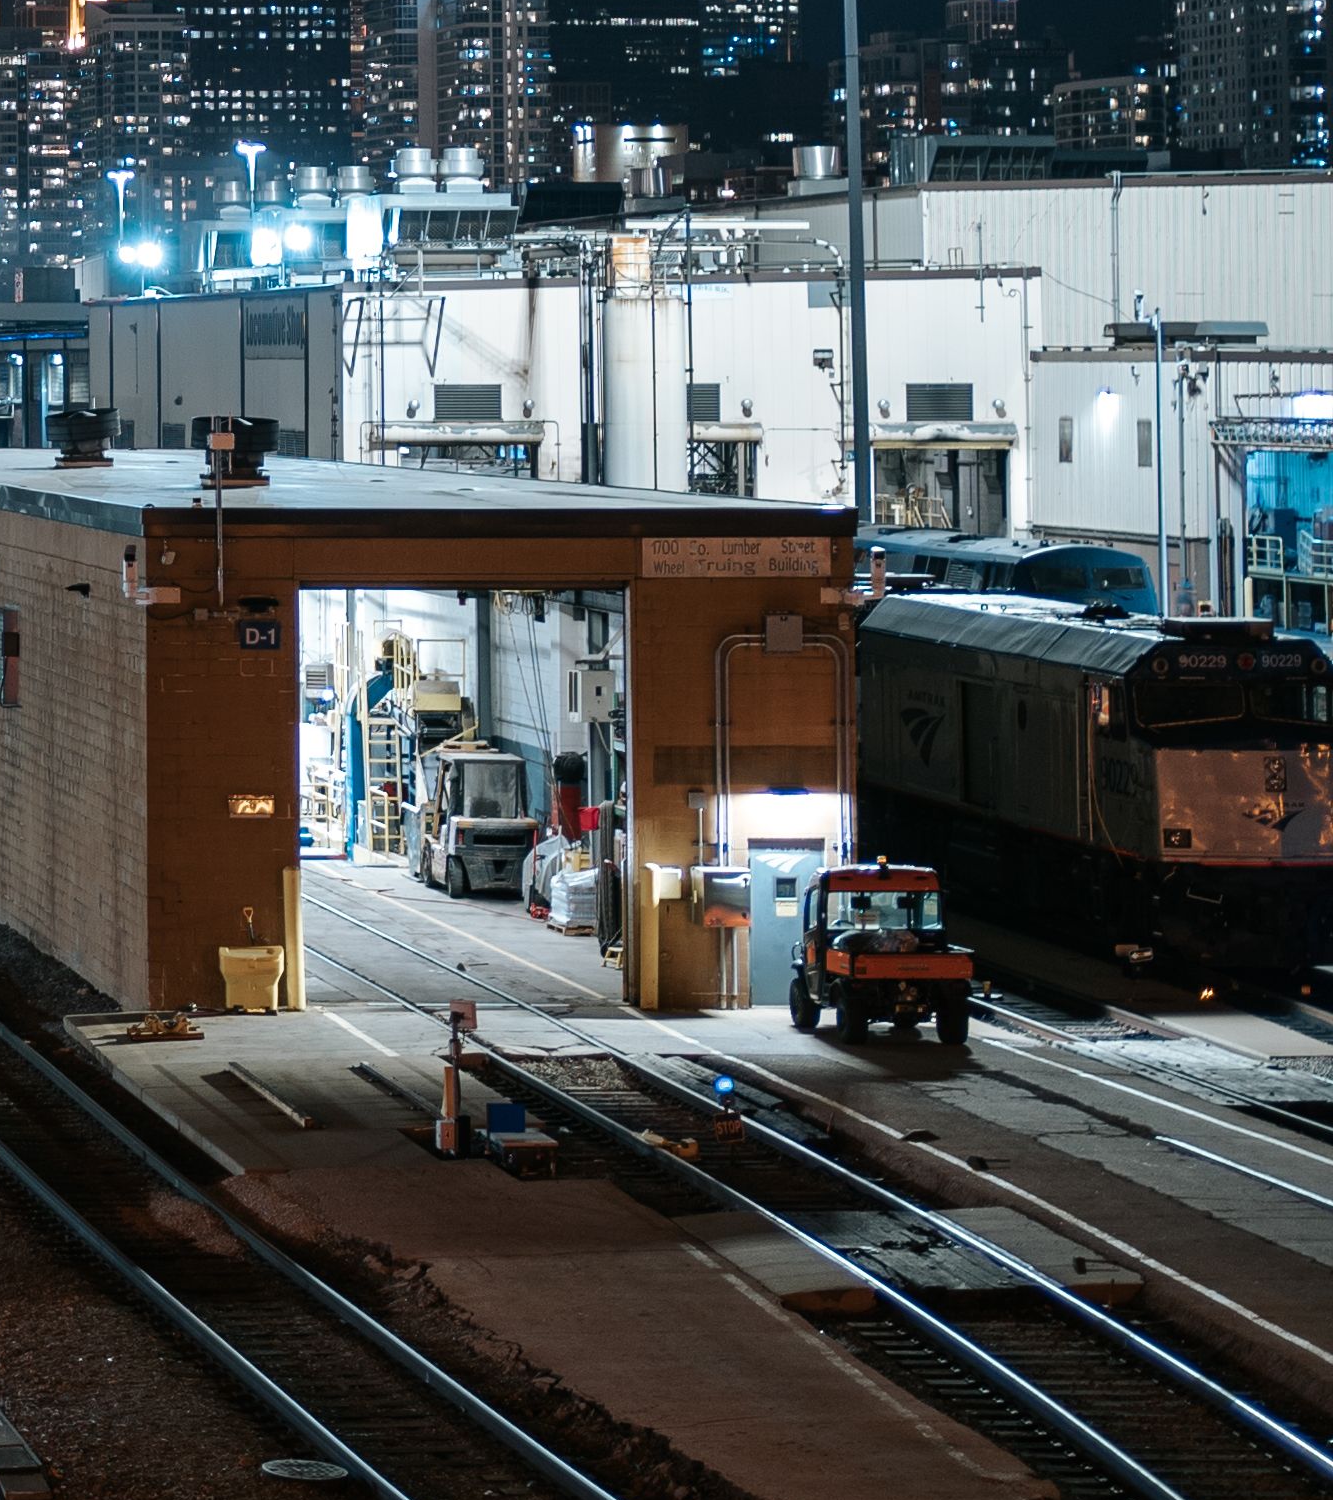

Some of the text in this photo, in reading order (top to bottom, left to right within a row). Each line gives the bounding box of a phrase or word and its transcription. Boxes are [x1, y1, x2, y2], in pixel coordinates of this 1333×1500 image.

[245, 304, 306, 350] Locomotive Shop
[653, 540, 679, 556] 1700
[721, 539, 761, 556] Lumber
[653, 559, 685, 575] Wheel
[769, 557, 820, 576] Building
[245, 628, 276, 645] D-1
[1178, 654, 1227, 668] 90229
[1261, 653, 1302, 667] 90229
[716, 1120, 742, 1136] STOP
